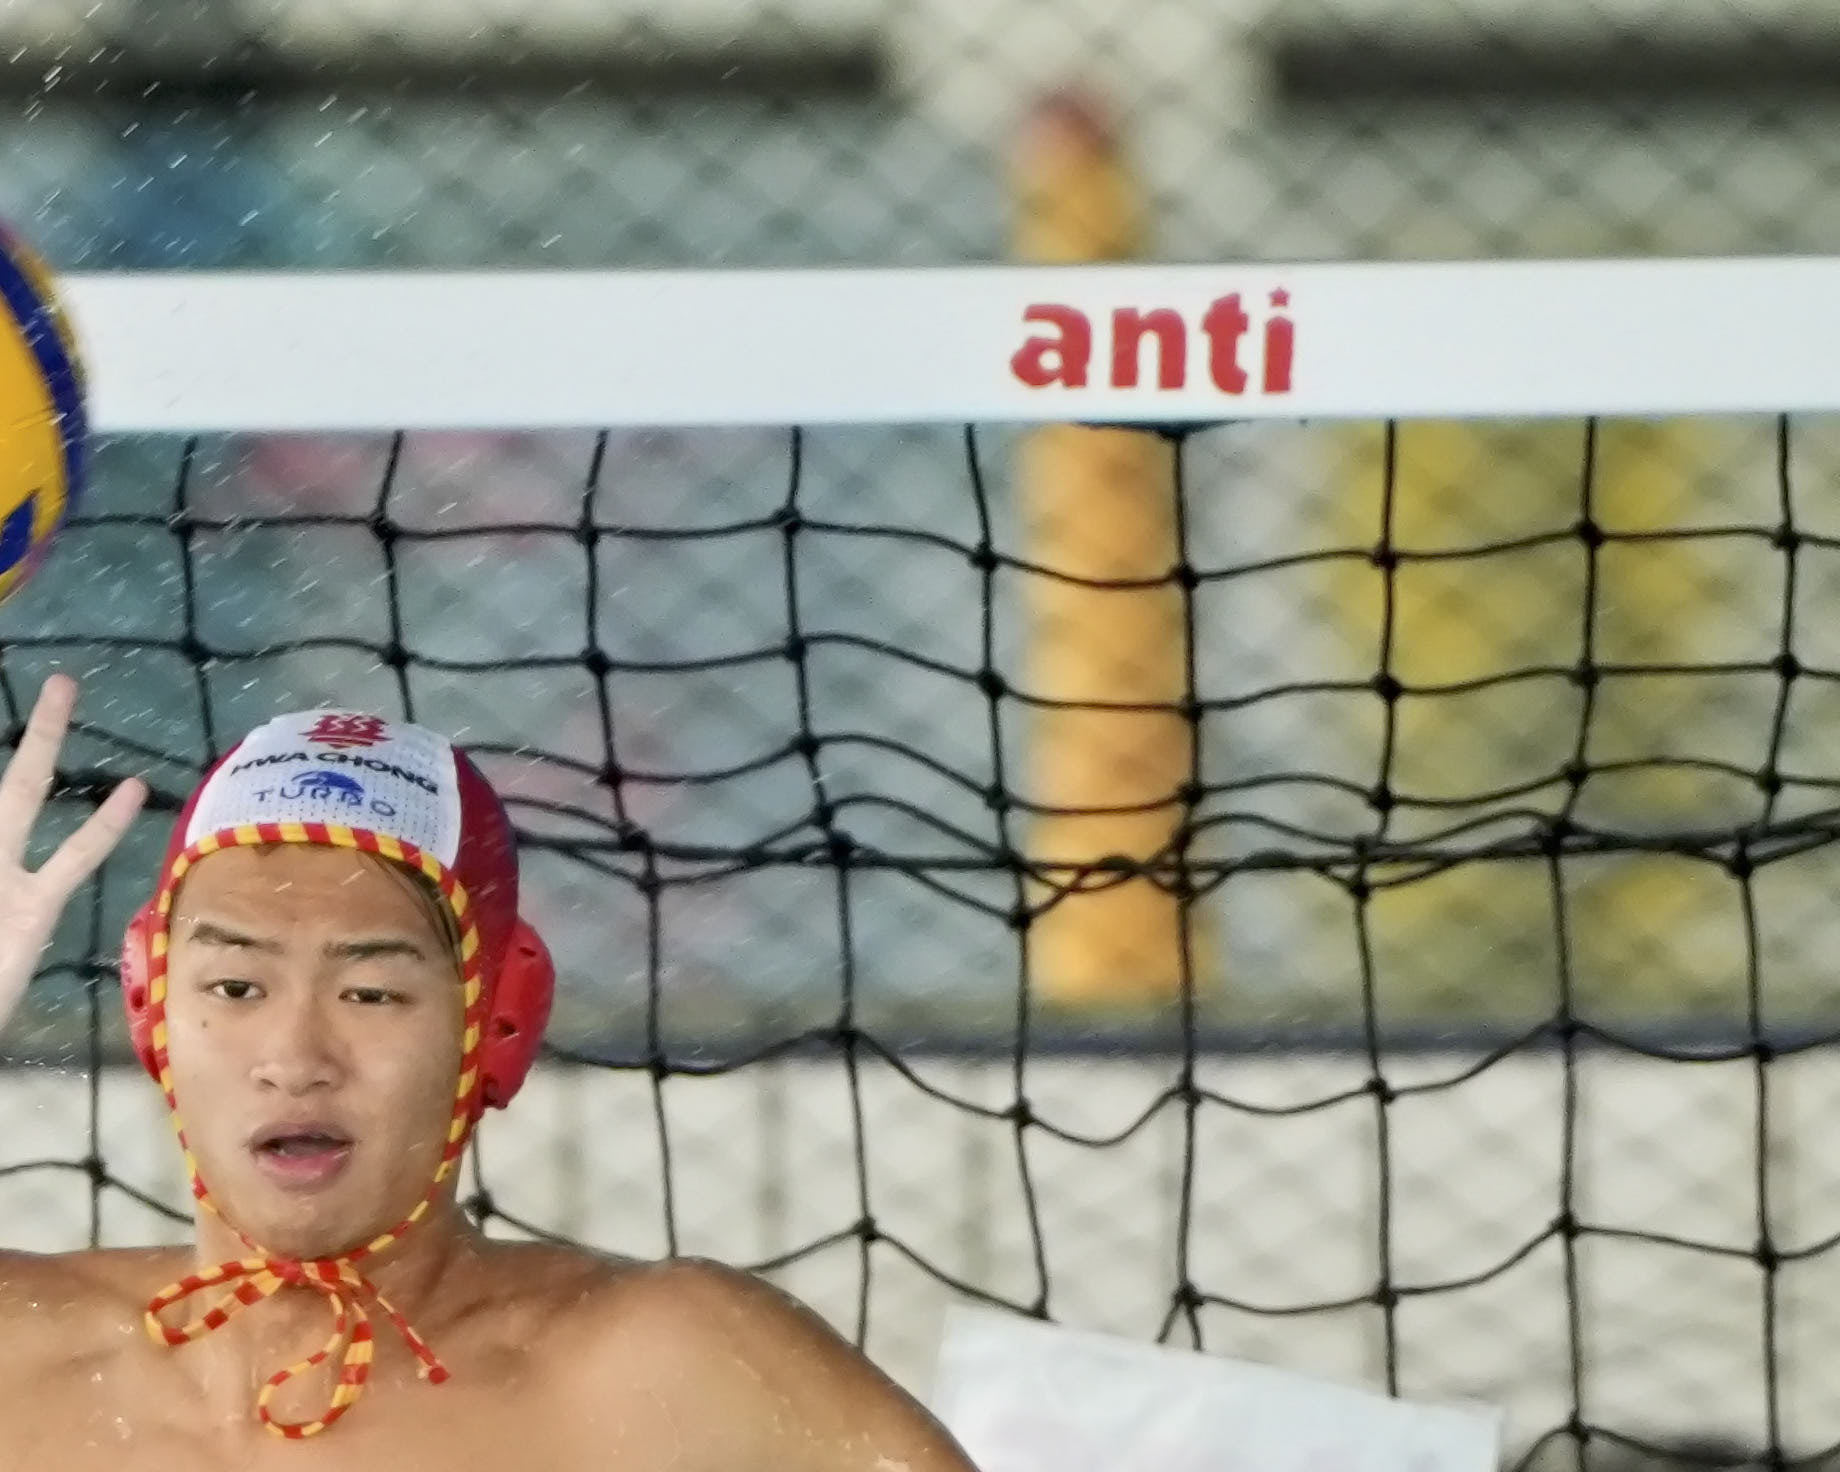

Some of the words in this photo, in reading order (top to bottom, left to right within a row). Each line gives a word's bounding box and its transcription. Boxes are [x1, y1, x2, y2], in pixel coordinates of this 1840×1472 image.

[1010, 287, 1294, 395] anti
[315, 752, 439, 795] CHONG
[252, 784, 396, 817] TURBO
